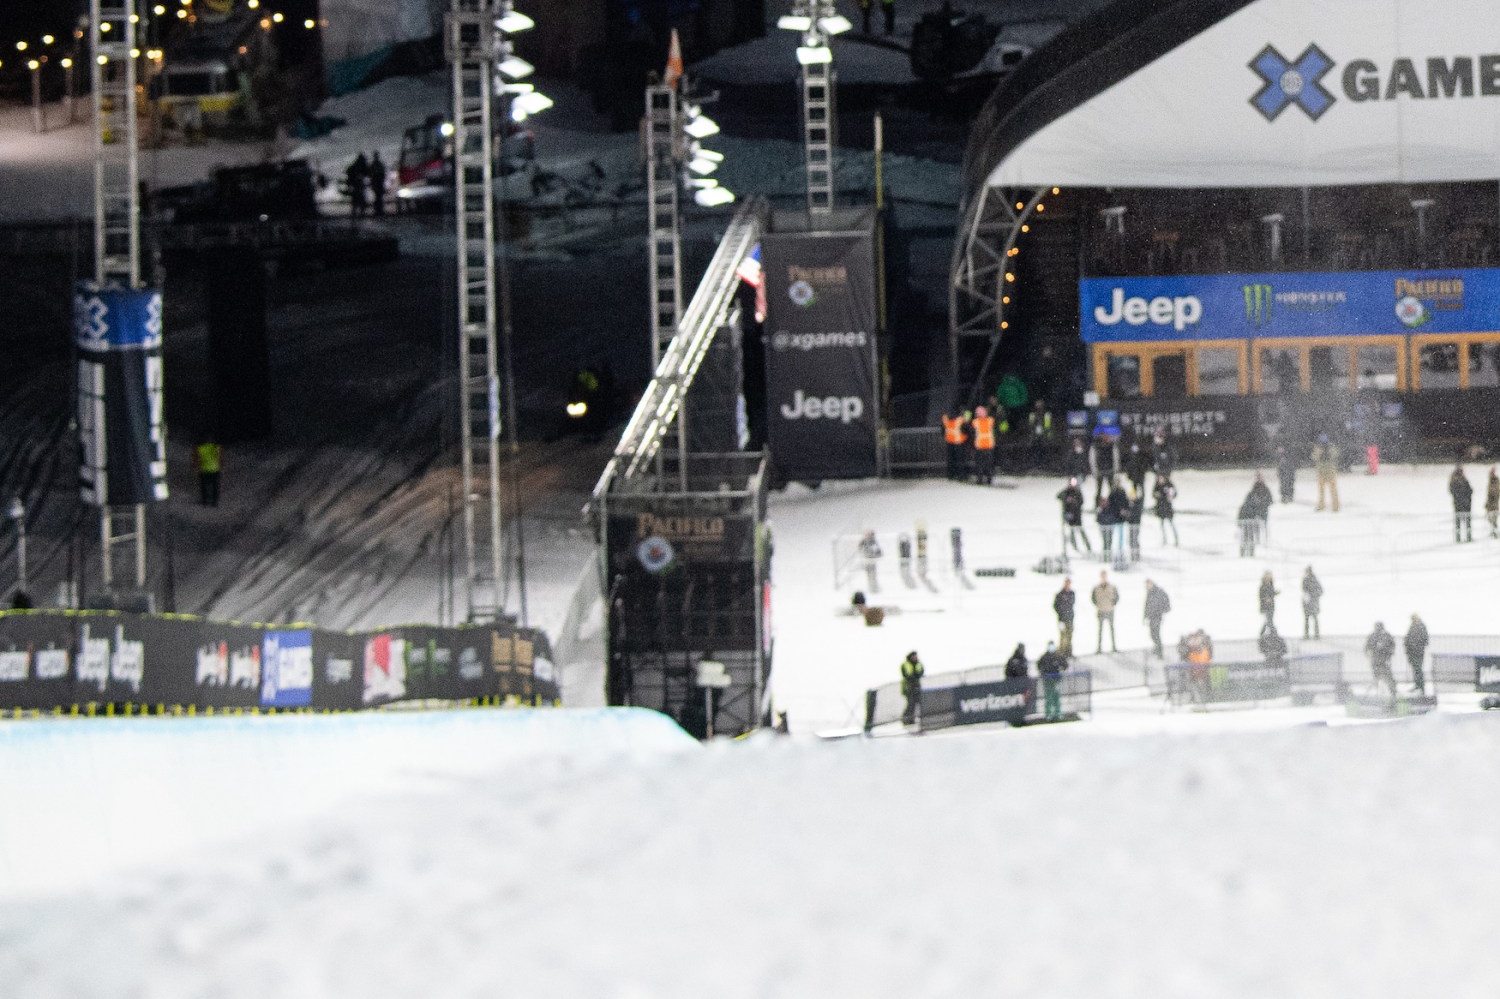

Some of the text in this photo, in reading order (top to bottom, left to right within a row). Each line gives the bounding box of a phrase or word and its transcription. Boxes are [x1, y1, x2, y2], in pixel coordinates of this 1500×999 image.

[1094, 287, 1202, 331] Jeep
[772, 331, 867, 350] @xgames
[780, 390, 864, 424] Jeep
[961, 694, 1026, 712] verizon
